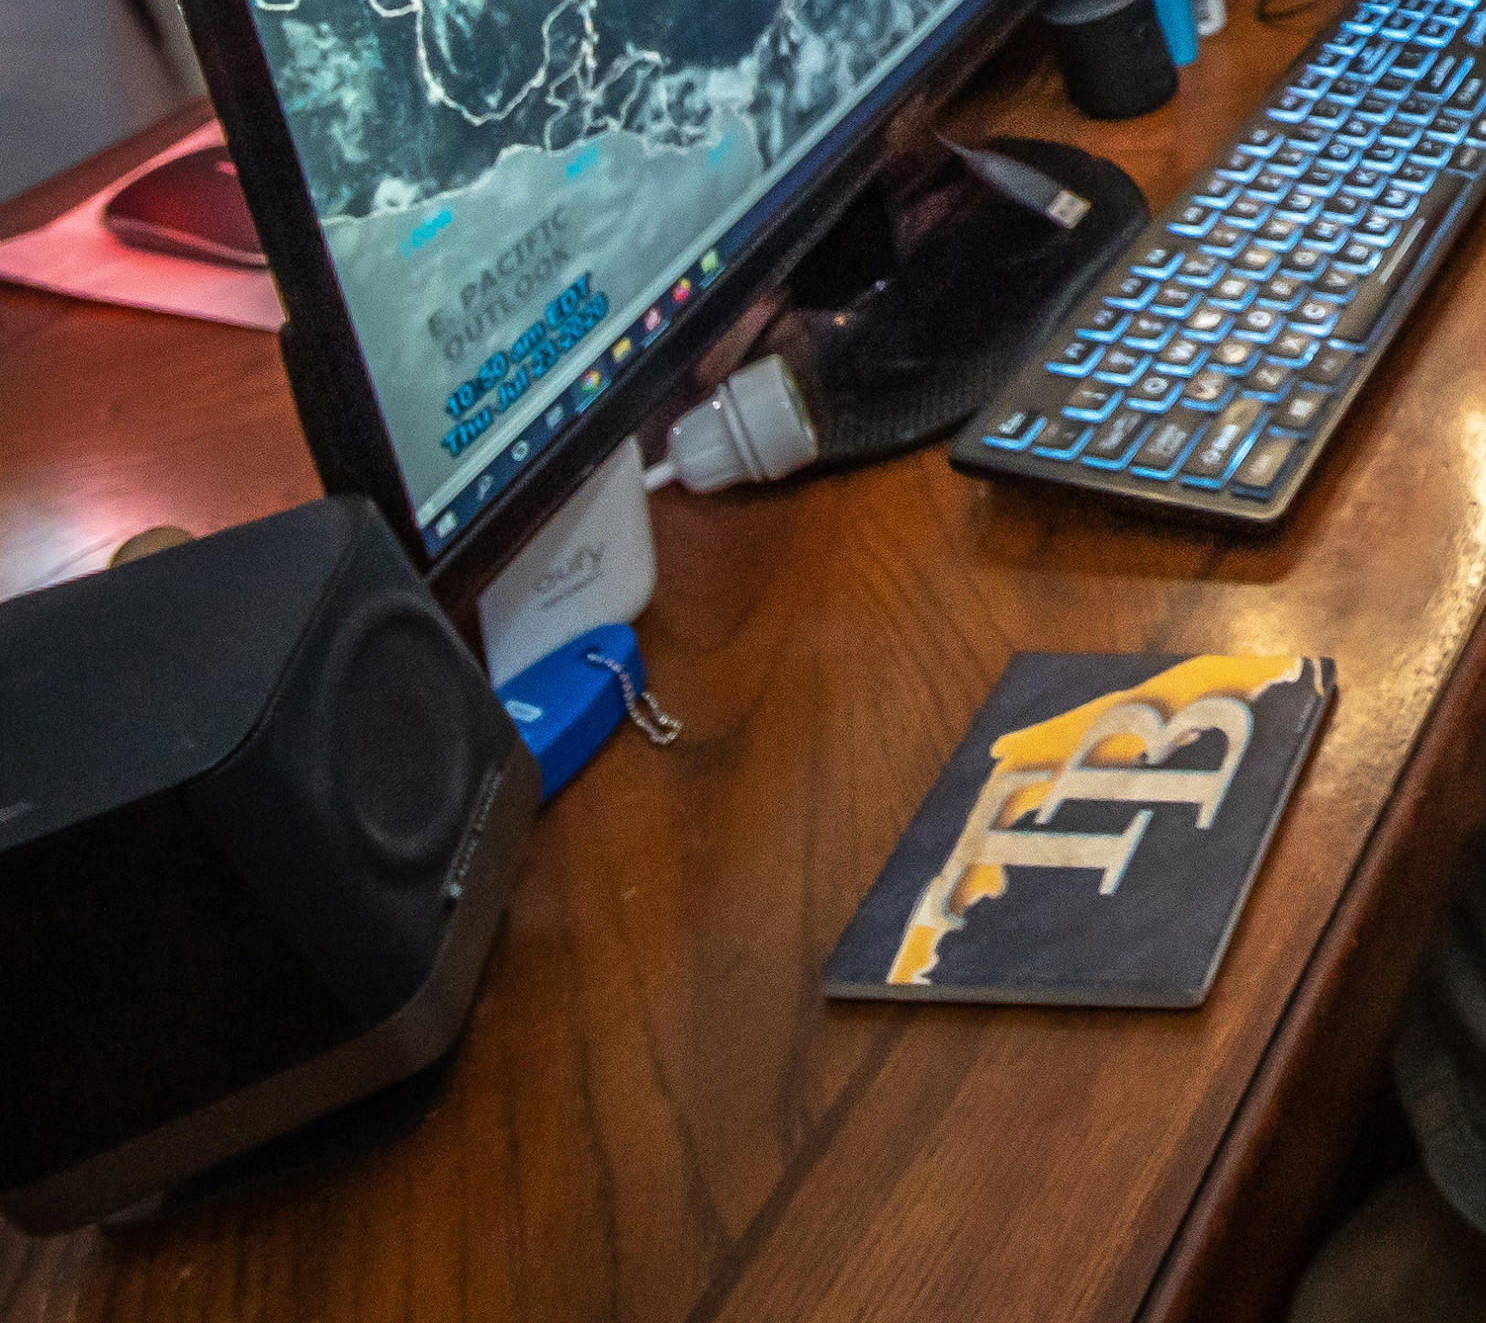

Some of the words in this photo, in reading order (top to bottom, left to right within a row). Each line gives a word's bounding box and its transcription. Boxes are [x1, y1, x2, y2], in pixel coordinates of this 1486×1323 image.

[444, 248, 572, 360] OUTLOOK
[460, 205, 569, 311] PACIFIC
[445, 349, 509, 419] 10:50
[510, 321, 546, 363] am
[545, 271, 592, 329] EDT
[441, 406, 493, 457] Thu
[497, 366, 530, 413] Jul
